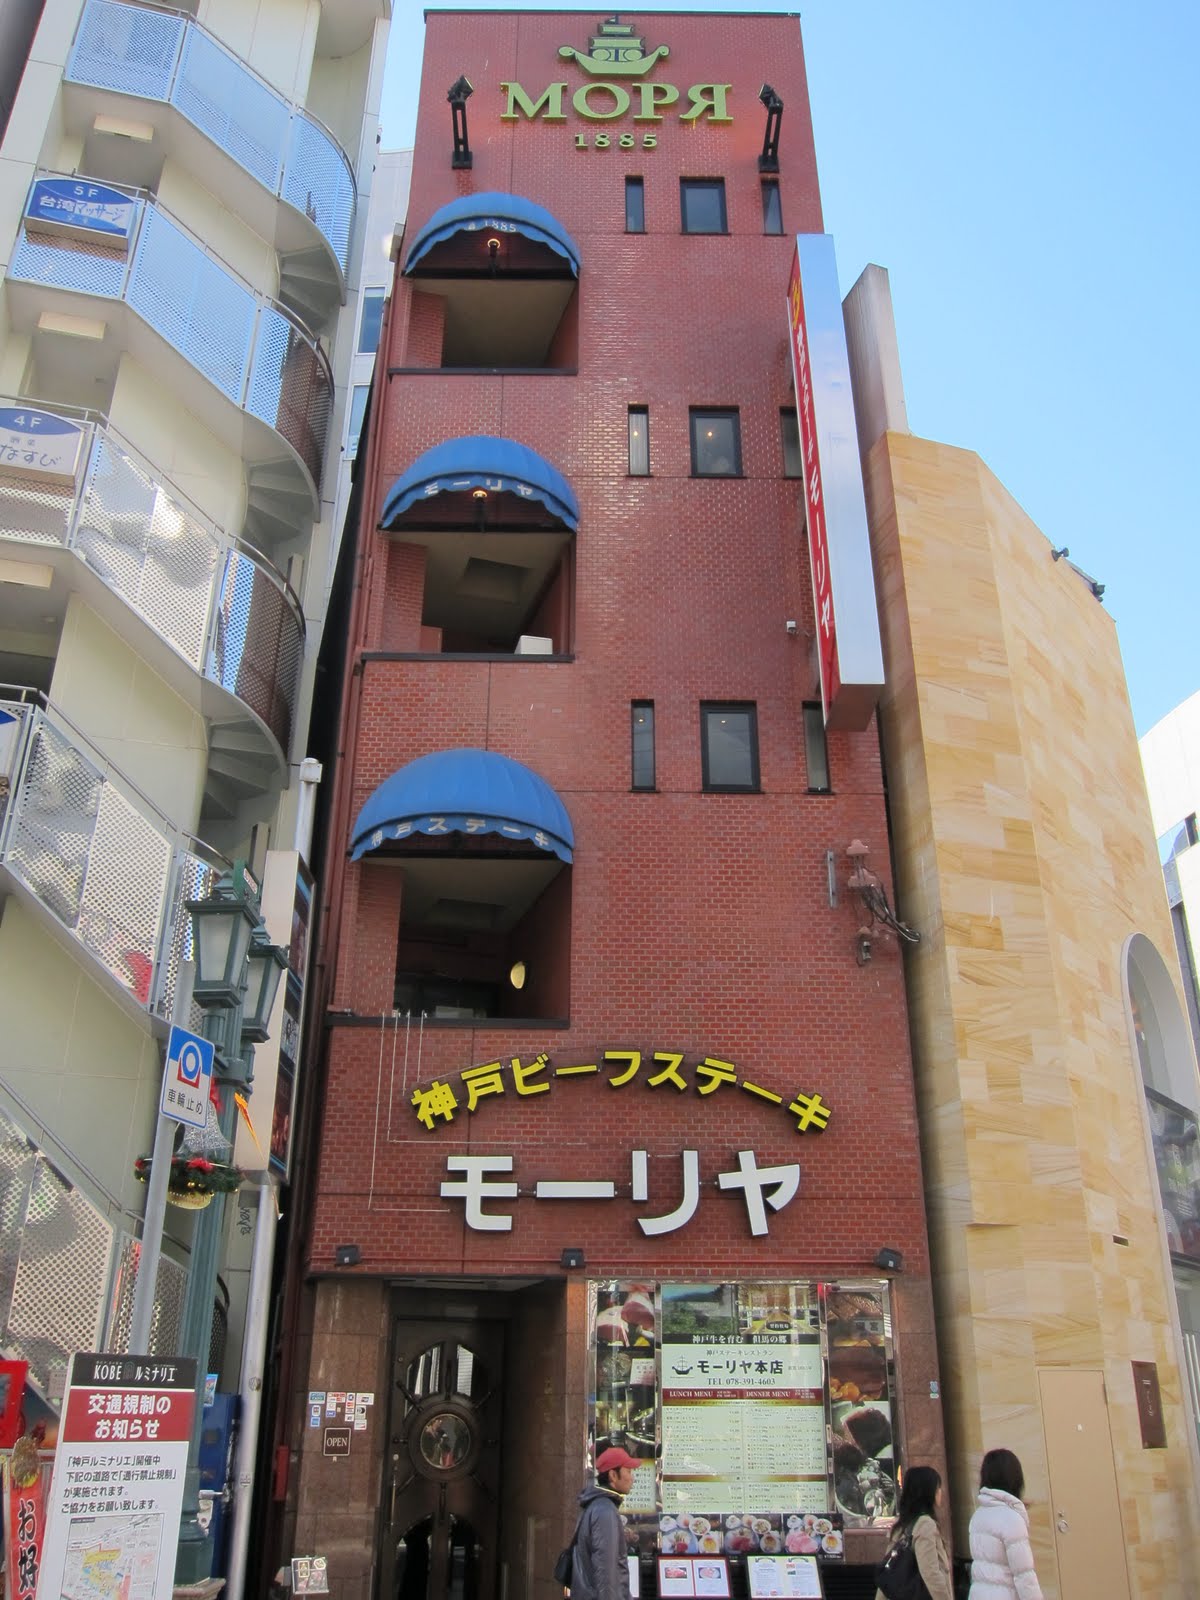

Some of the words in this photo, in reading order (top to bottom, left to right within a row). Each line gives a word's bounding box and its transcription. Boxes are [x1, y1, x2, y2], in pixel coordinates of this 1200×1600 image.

[575, 133, 658, 148] 1885
[40, 195, 126, 222] 台湾マッサージ
[484, 219, 517, 232] 1885
[14, 415, 42, 428] 4F
[424, 479, 533, 496] モーリヤ
[810, 465, 831, 639] モーリヤ
[371, 817, 549, 848] 神戸ステーキ
[411, 1050, 831, 1132] 神戸ビーフステーキ
[440, 1150, 800, 1236] モーリヤ
[692, 1334, 744, 1344] 神戸牛を育む
[94, 1364, 122, 1380] KOBE
[134, 1366, 176, 1382] ルミナリエ
[697, 1360, 784, 1375] モーリヤ本店
[726, 1378, 776, 1386] 078-391-4603
[88, 1393, 171, 1415] 交通規制の
[95, 1419, 160, 1439] お知らせ
[326, 1437, 348, 1447] OPEN
[67, 1455, 161, 1467] 「神戸ルミナリエ」開催中
[63, 1485, 129, 1498] が実施されます。
[18, 1498, 38, 1600] お好
